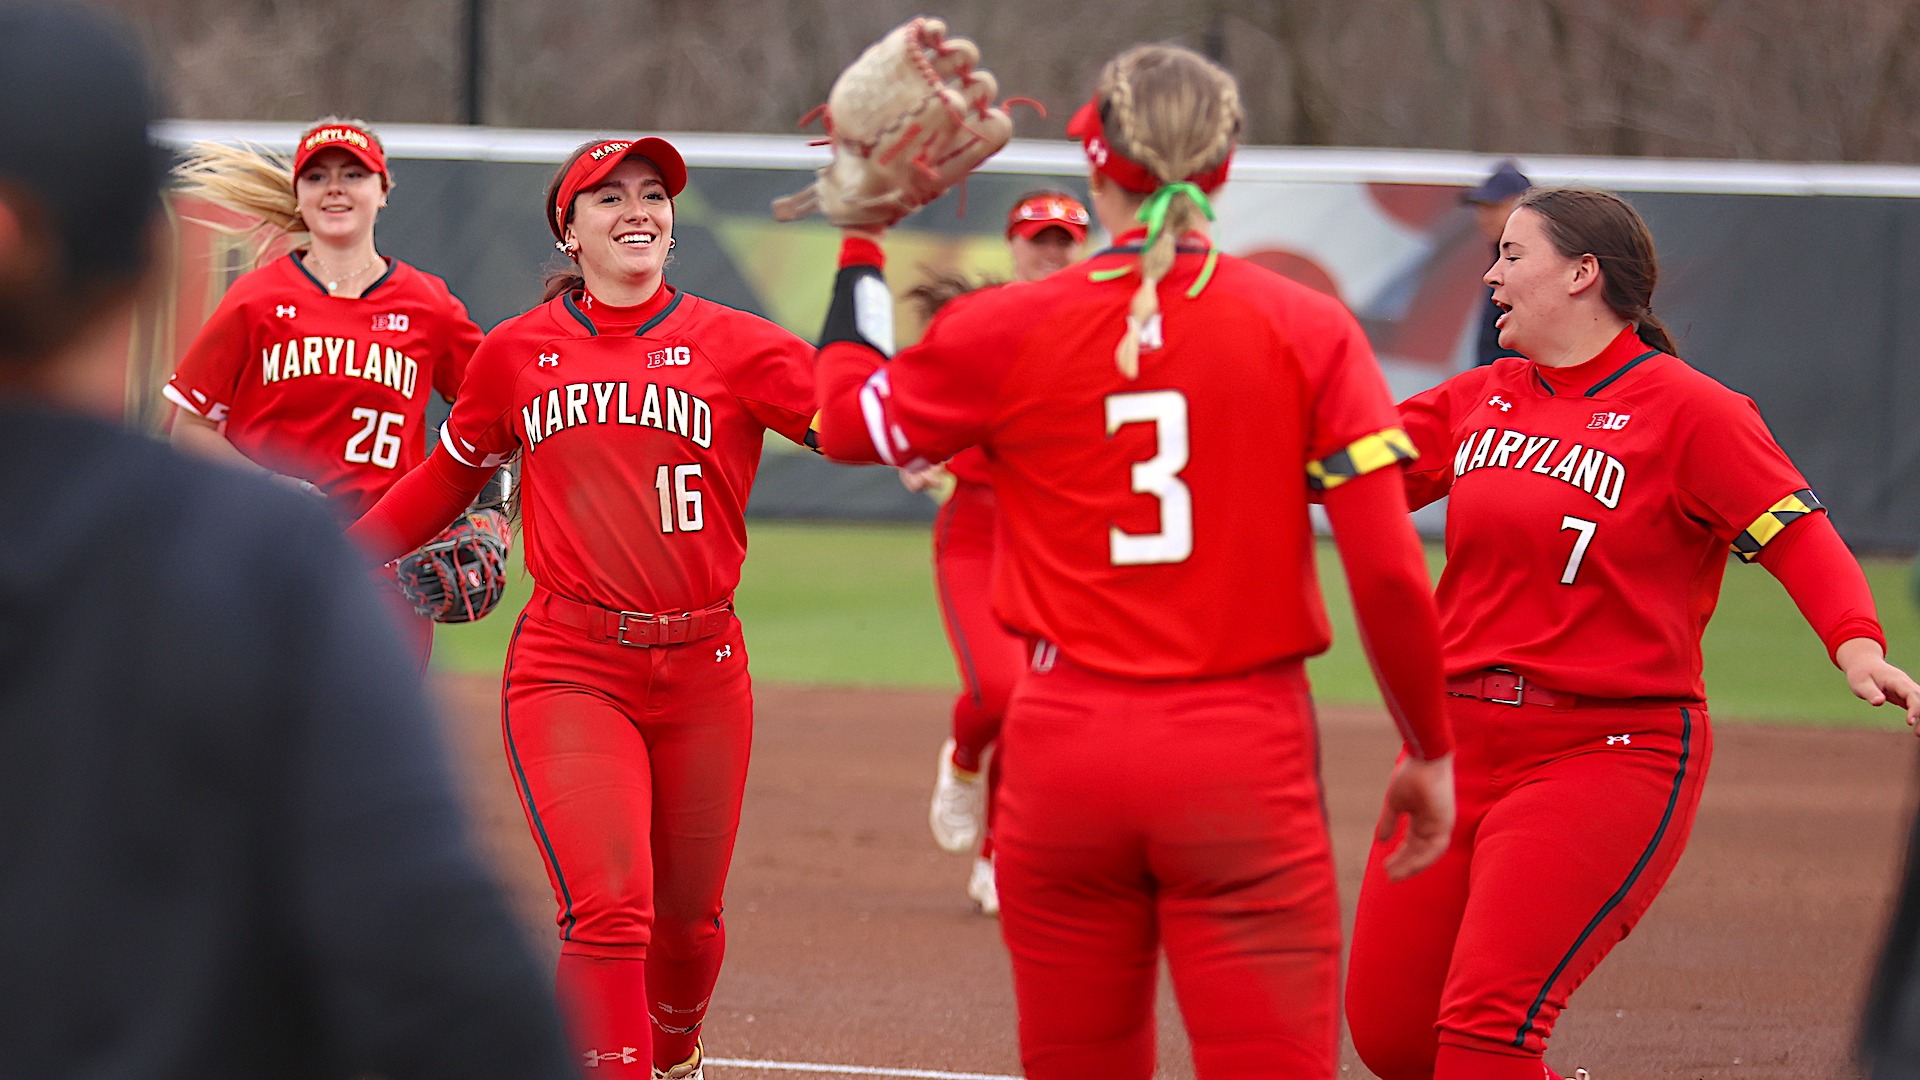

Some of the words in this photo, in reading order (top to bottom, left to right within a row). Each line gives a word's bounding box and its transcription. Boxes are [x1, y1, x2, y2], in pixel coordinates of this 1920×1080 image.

[304, 128, 369, 151] MARYLAND
[590, 142, 633, 161] MARY
[262, 336, 418, 401] MARYLAND
[344, 406, 406, 470] 26
[520, 381, 714, 454] MARYLAND
[654, 462, 706, 535] 16
[1104, 388, 1194, 567] 3
[1453, 427, 1628, 510] MARYLAND
[1558, 514, 1599, 586] 7
